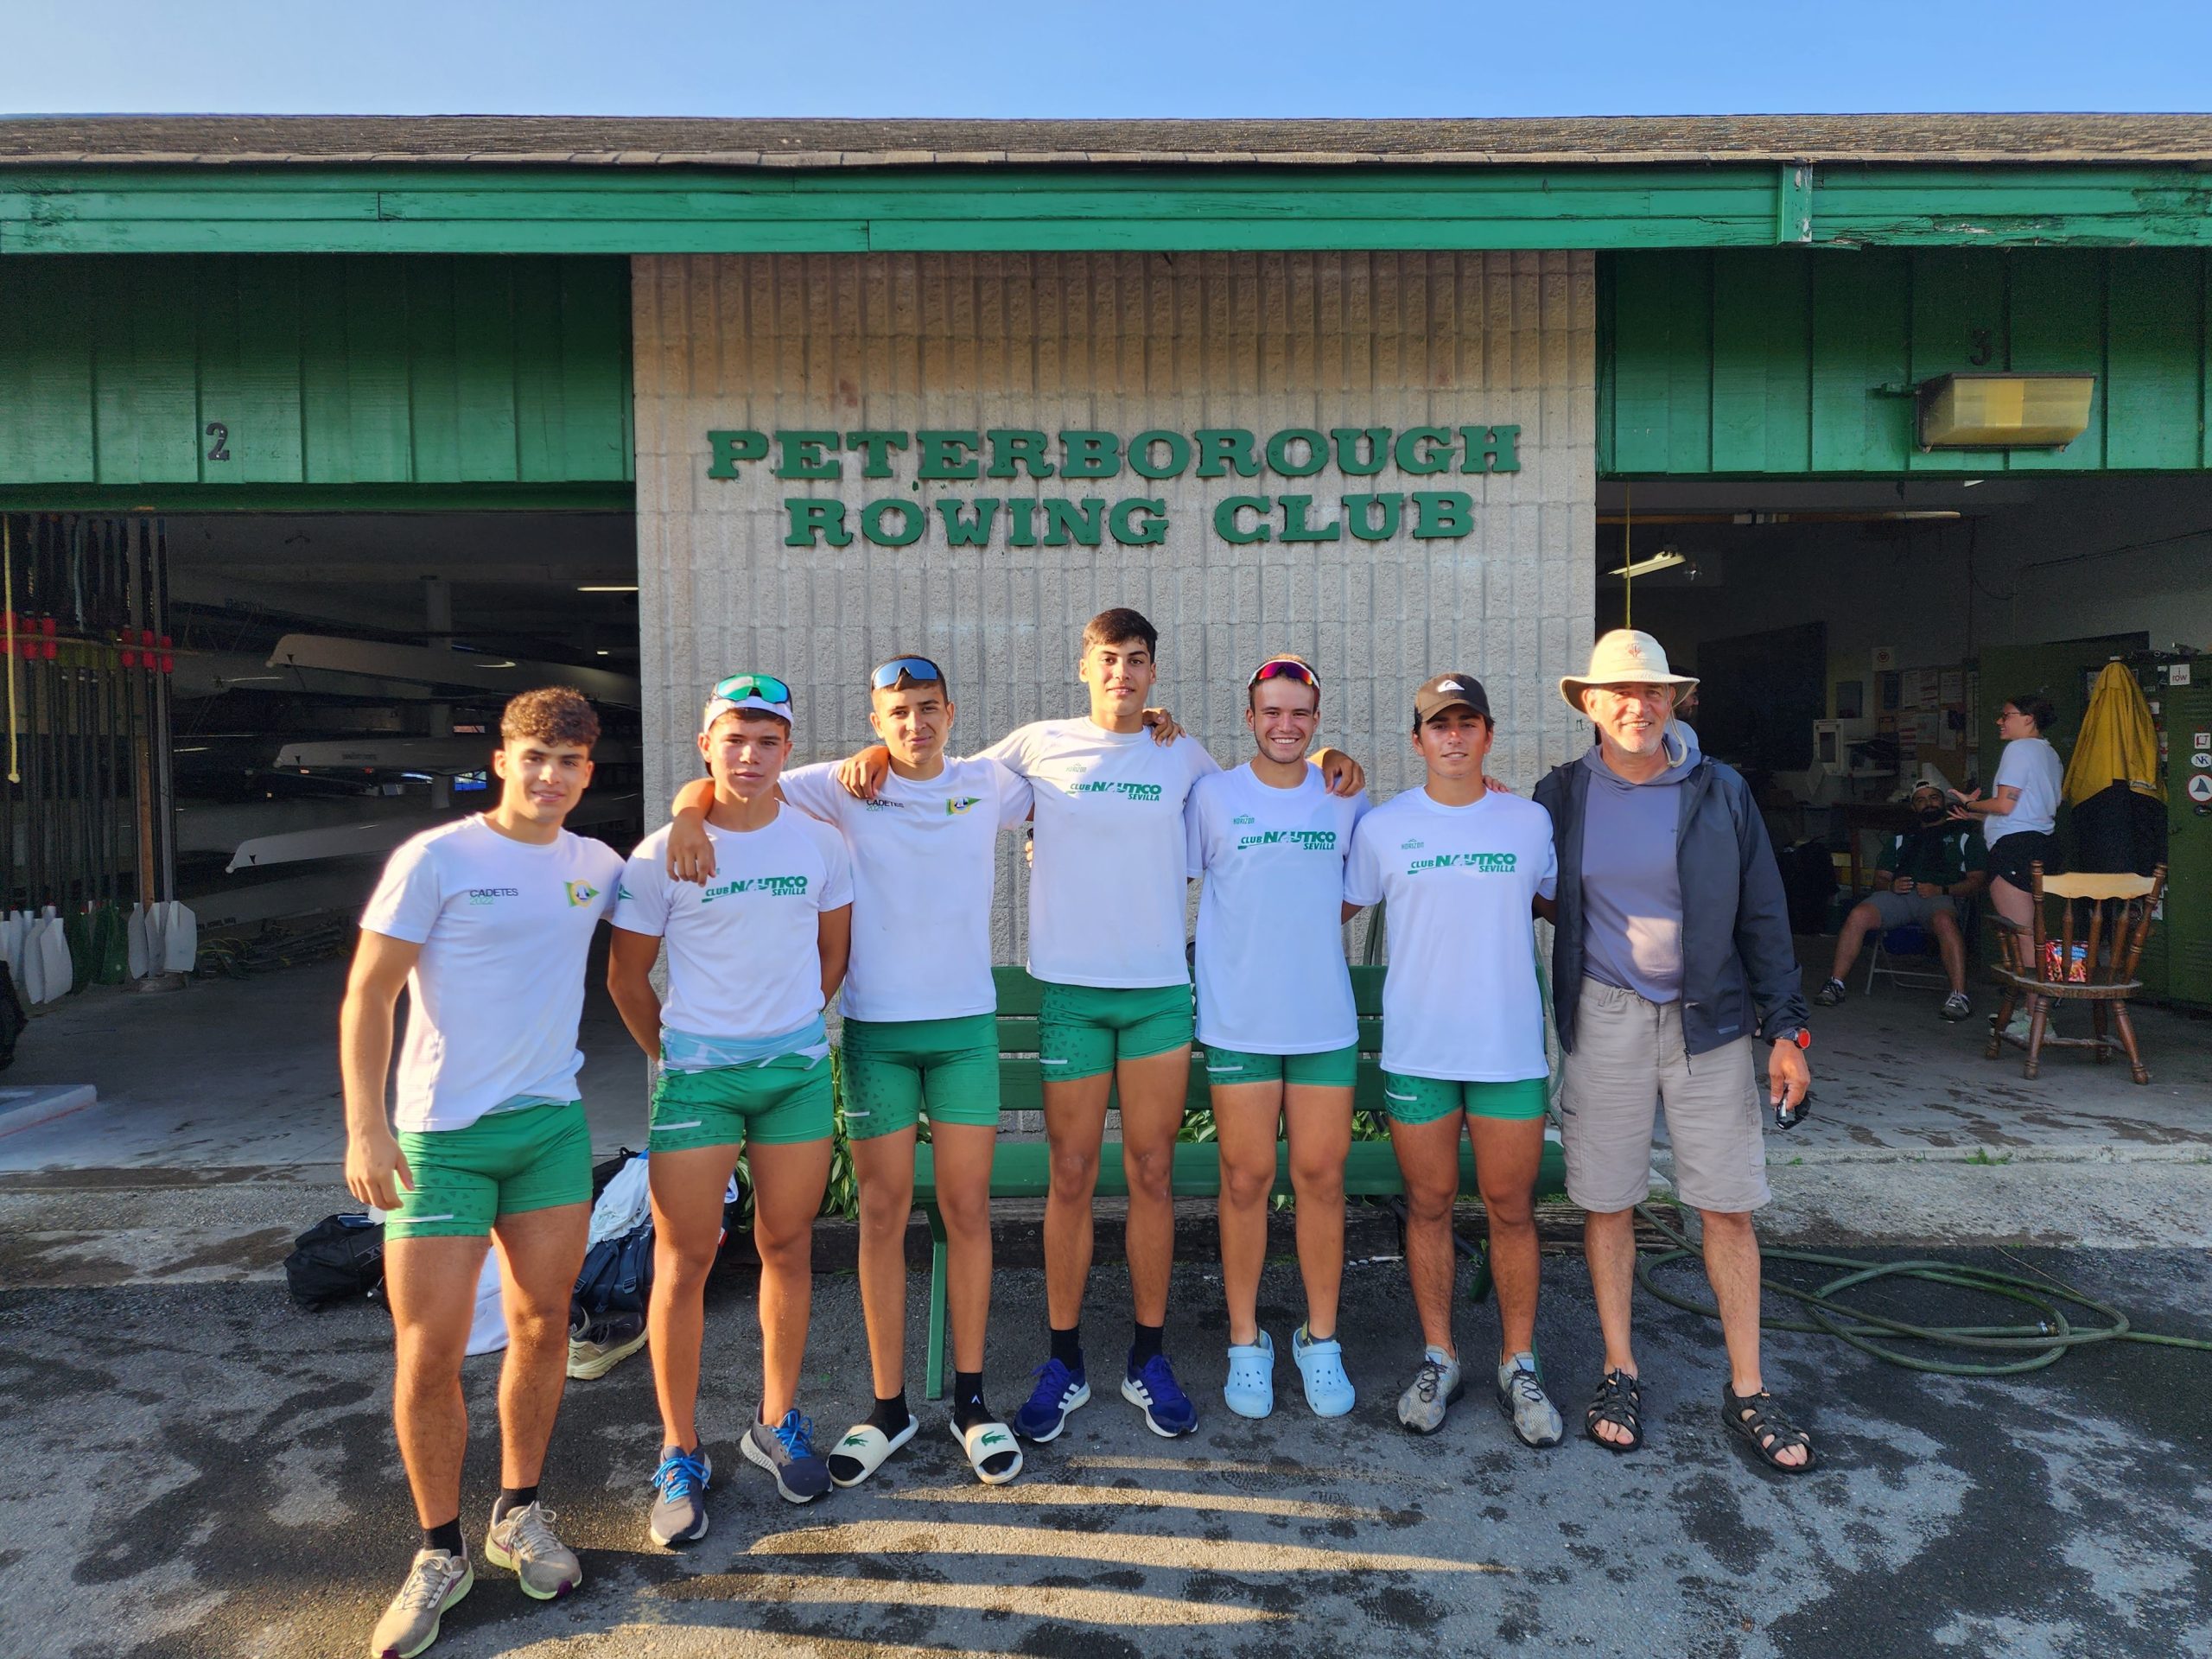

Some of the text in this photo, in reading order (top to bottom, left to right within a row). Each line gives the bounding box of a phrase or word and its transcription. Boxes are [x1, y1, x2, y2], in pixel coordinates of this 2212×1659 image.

[207, 423, 230, 461] 2
[707, 424, 1521, 479] PETERBOROUGH
[785, 491, 1475, 547] ROWING CLUB
[2196, 756, 2209, 765] NK
[867, 798, 904, 808] CADETES
[1241, 836, 1262, 844] CLUB
[1411, 860, 1434, 868] CLUB
[469, 887, 518, 898] CADETES
[705, 887, 729, 897] CLUB
[772, 887, 806, 897] SEVILLA
